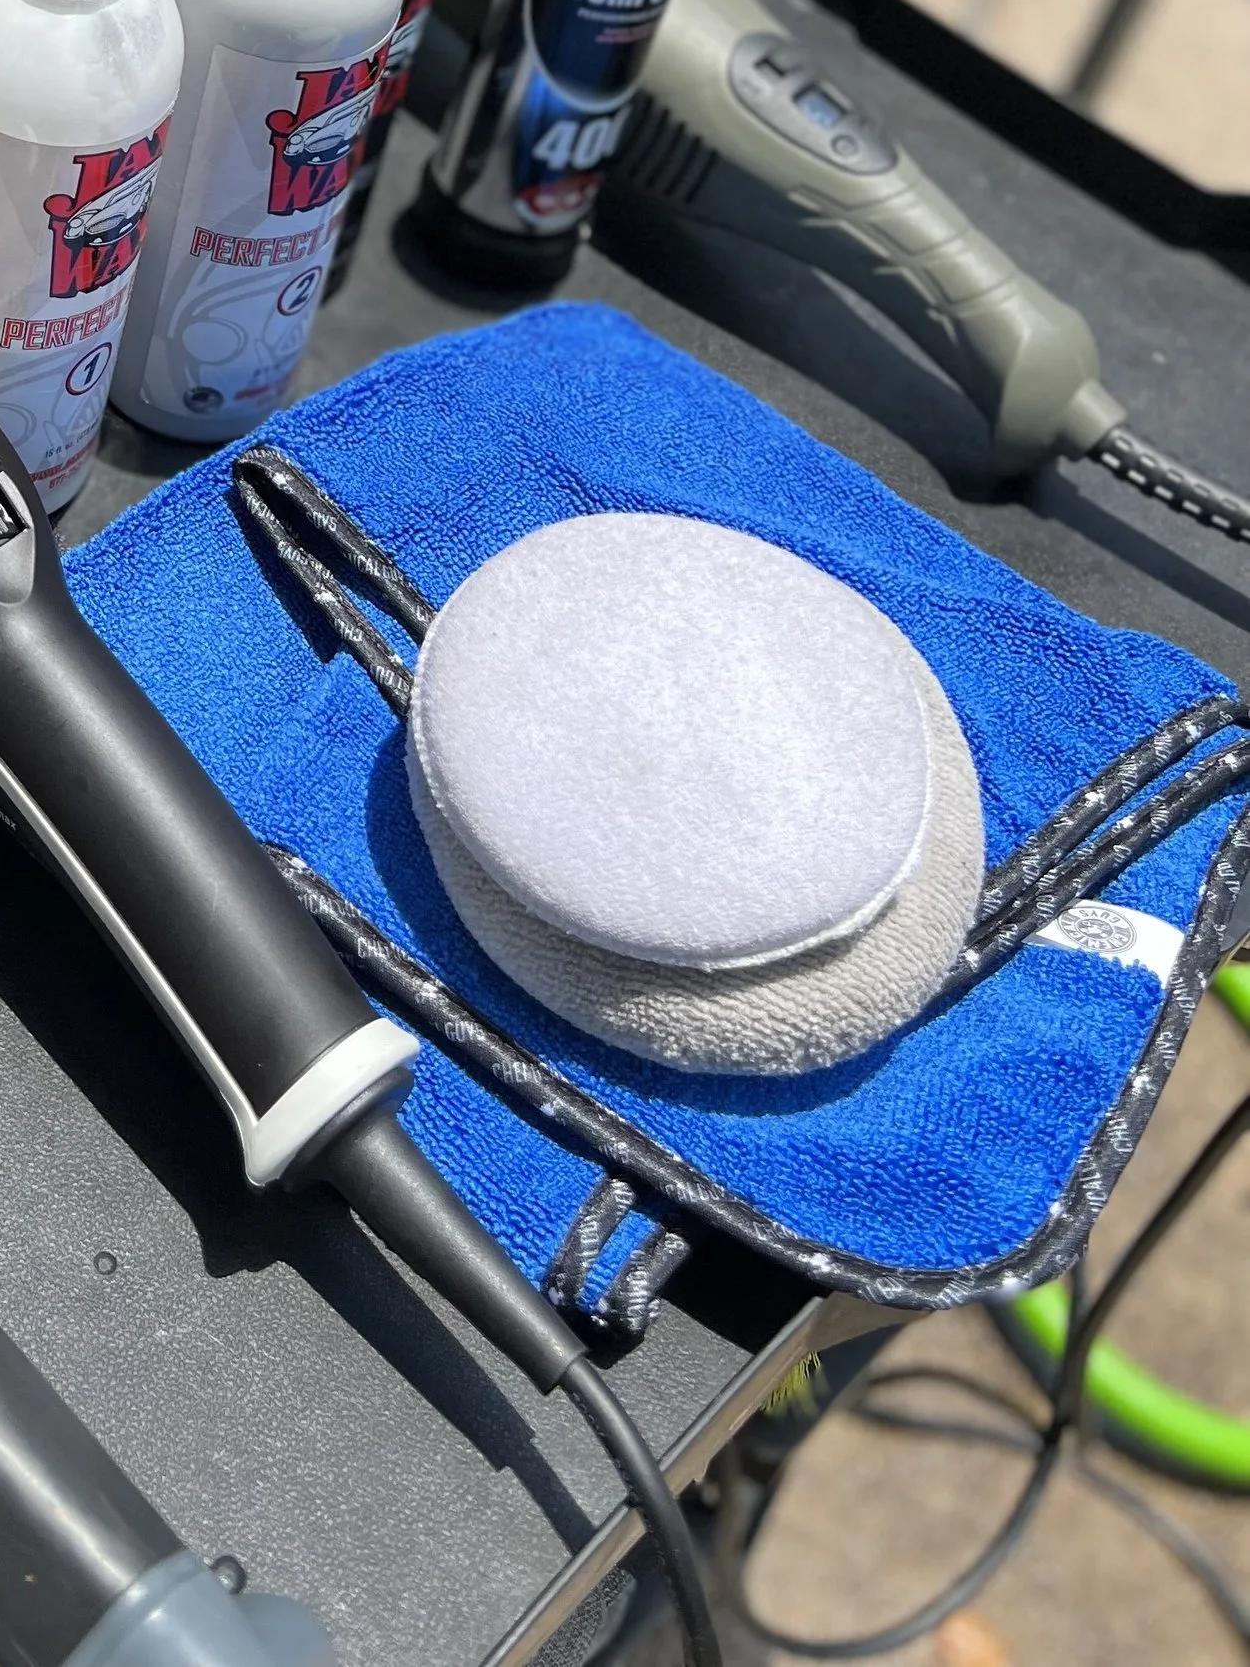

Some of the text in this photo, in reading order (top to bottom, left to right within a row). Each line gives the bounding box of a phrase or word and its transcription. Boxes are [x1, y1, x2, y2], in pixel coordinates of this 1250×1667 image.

[190, 222, 326, 267] PERFECT
[287, 272, 316, 311] 2
[0, 288, 129, 350] PERFECT
[83, 352, 101, 386] 1
[1077, 908, 1121, 924] GUYS
